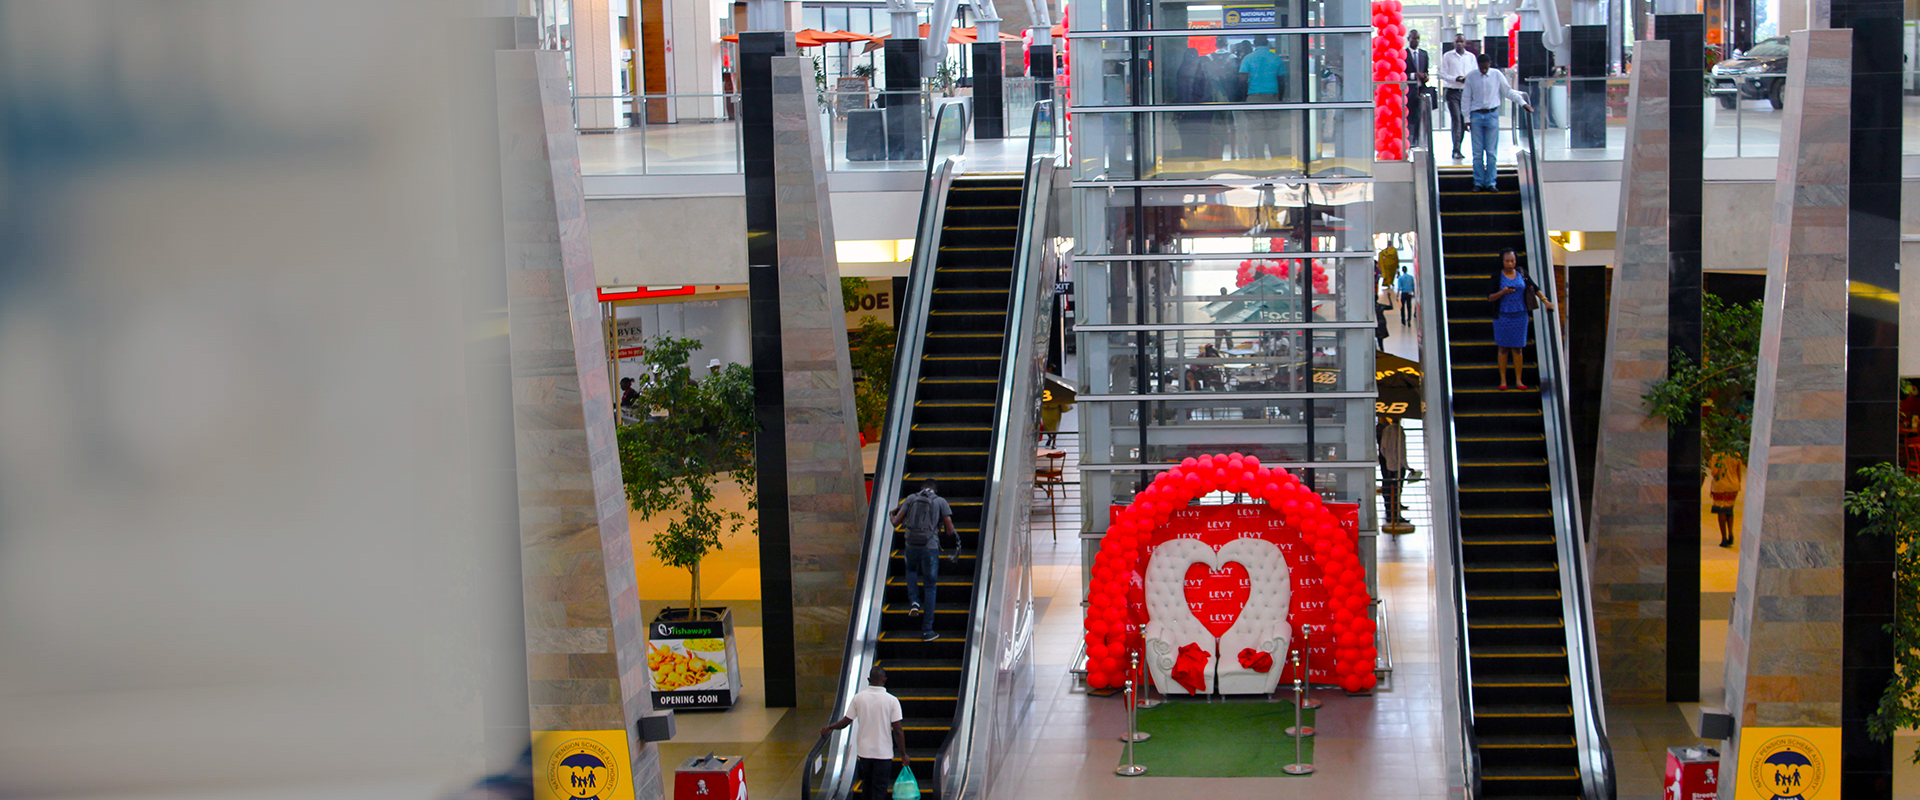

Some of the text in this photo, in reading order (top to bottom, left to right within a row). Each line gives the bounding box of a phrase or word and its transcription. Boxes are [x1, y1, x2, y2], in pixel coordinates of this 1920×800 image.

[849, 293, 890, 312] JOE
[1375, 402, 1409, 414] &B
[1207, 521, 1232, 529] LEVY
[1184, 579, 1204, 587] EVY
[1300, 578, 1324, 586] LEVY
[1209, 591, 1234, 599] LEVY
[672, 627, 712, 636] fishaways
[660, 694, 718, 705] OPENING SOON
[550, 742, 616, 791] NATIONAL PENSION SCHEME AUTHORITY
[1753, 738, 1822, 790] NATIONAL PENSION SCHEME AUTHORITY
